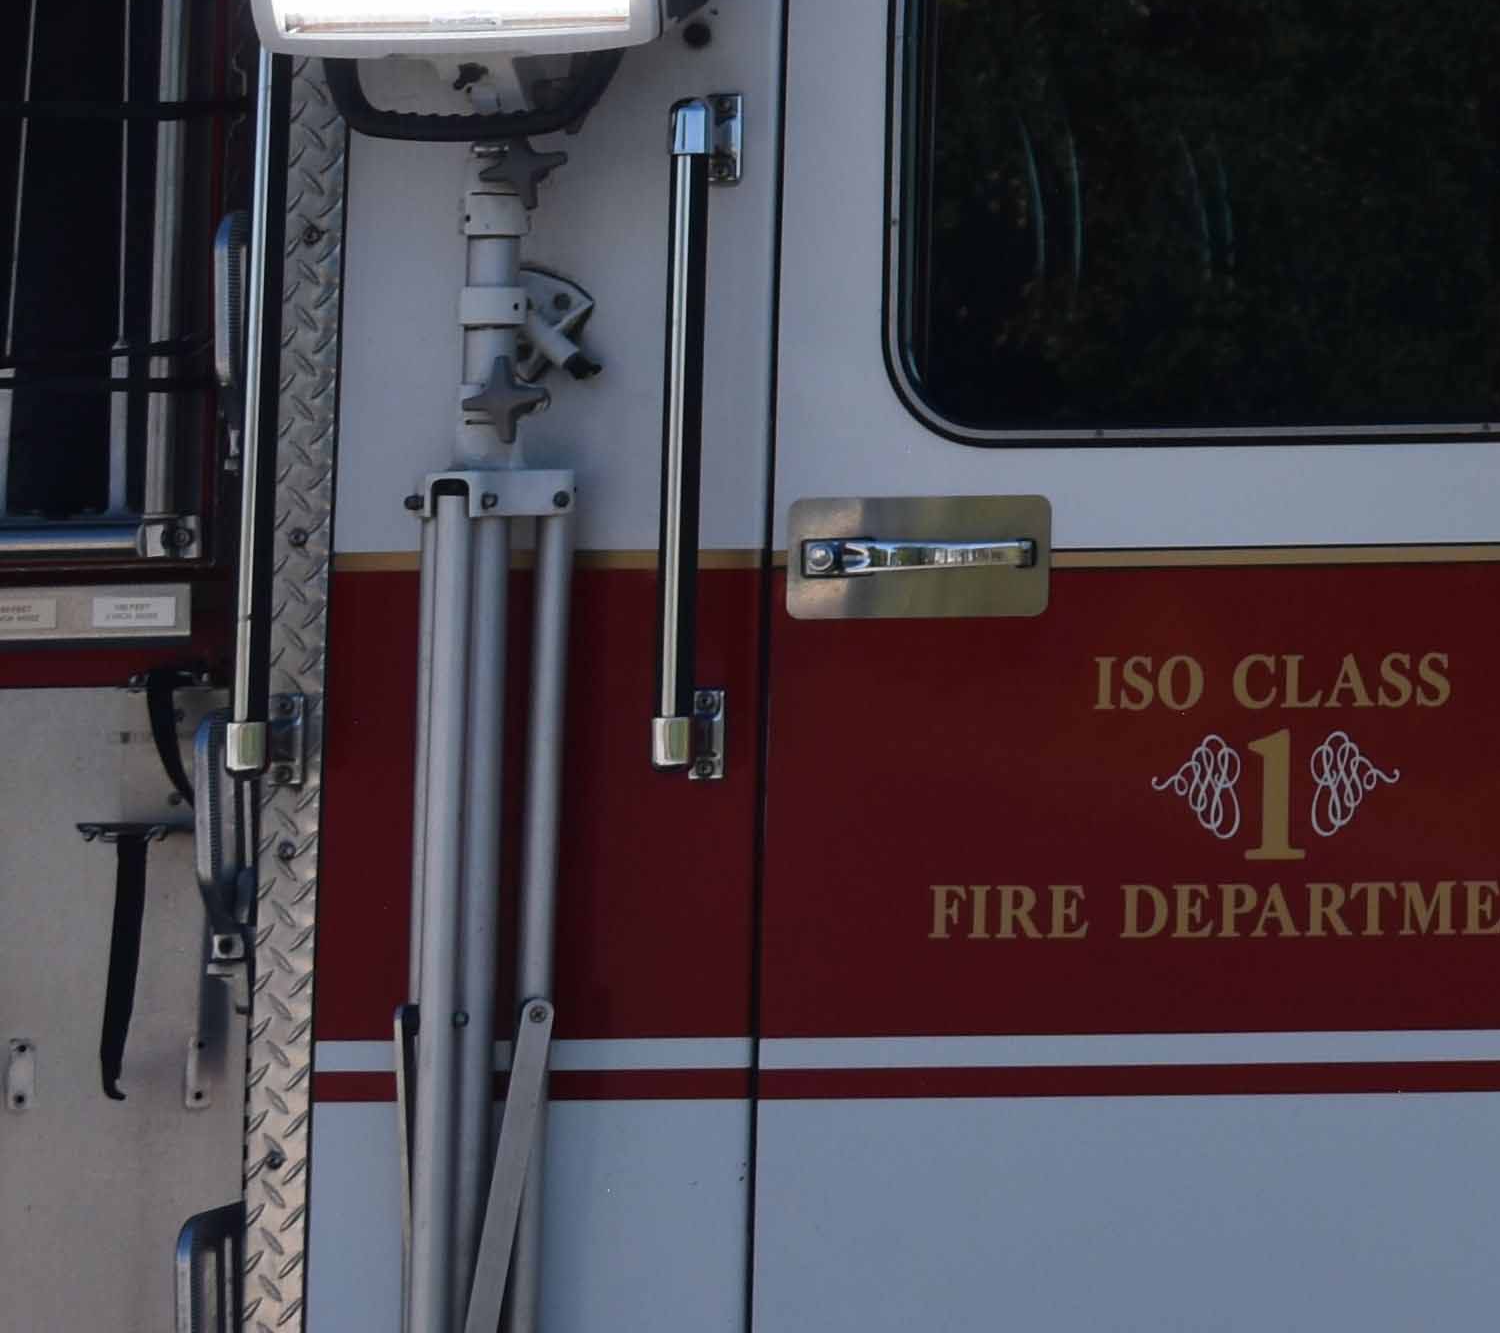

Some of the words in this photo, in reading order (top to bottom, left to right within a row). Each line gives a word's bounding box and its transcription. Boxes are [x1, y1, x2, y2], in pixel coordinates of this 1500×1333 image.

[1094, 655, 1204, 711] ISO
[1232, 652, 1451, 709] CLASS
[1244, 729, 1305, 860] 1
[928, 884, 1089, 939] FIRE
